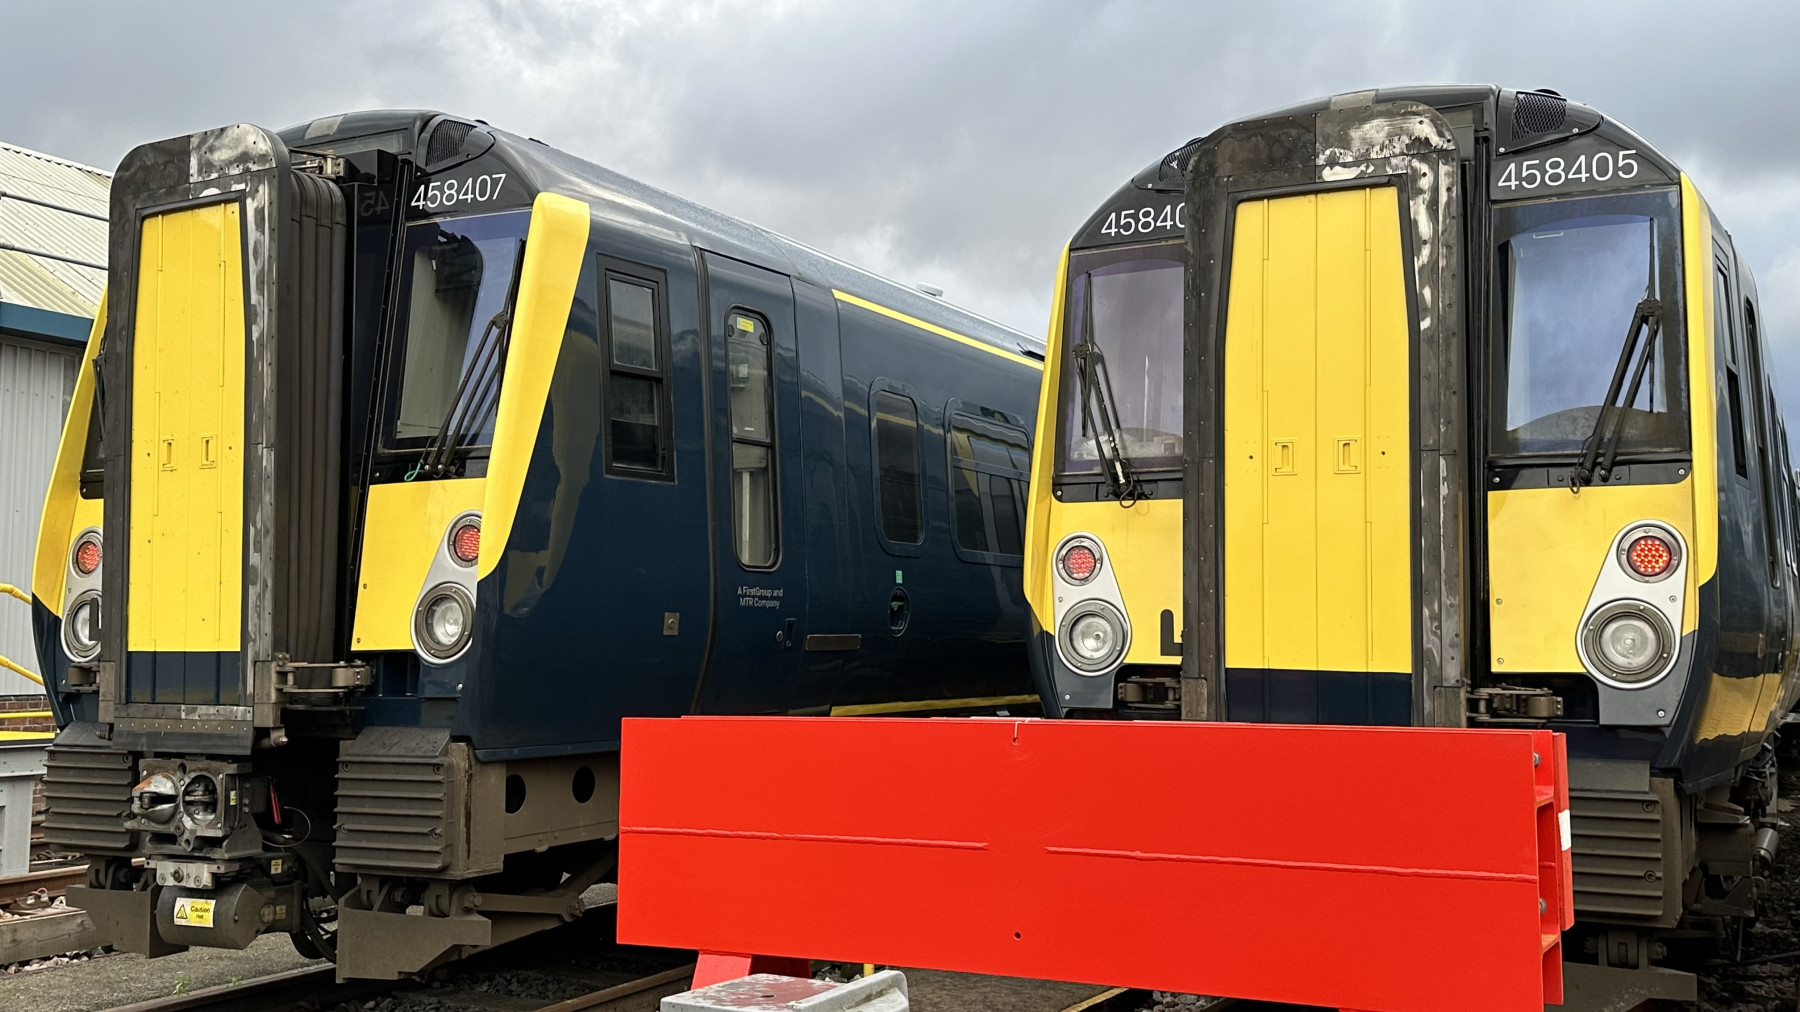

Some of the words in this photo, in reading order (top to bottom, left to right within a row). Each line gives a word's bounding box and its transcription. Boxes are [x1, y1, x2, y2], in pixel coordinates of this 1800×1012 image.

[1498, 150, 1638, 190] 458405
[411, 173, 506, 210] 458407
[1101, 203, 1185, 236] 45840
[737, 586, 743, 596] A
[743, 586, 773, 598] FirstGroup
[773, 588, 784, 597] and
[740, 597, 754, 607] MTR
[754, 597, 780, 610] Company
[190, 905, 211, 914] Caution
